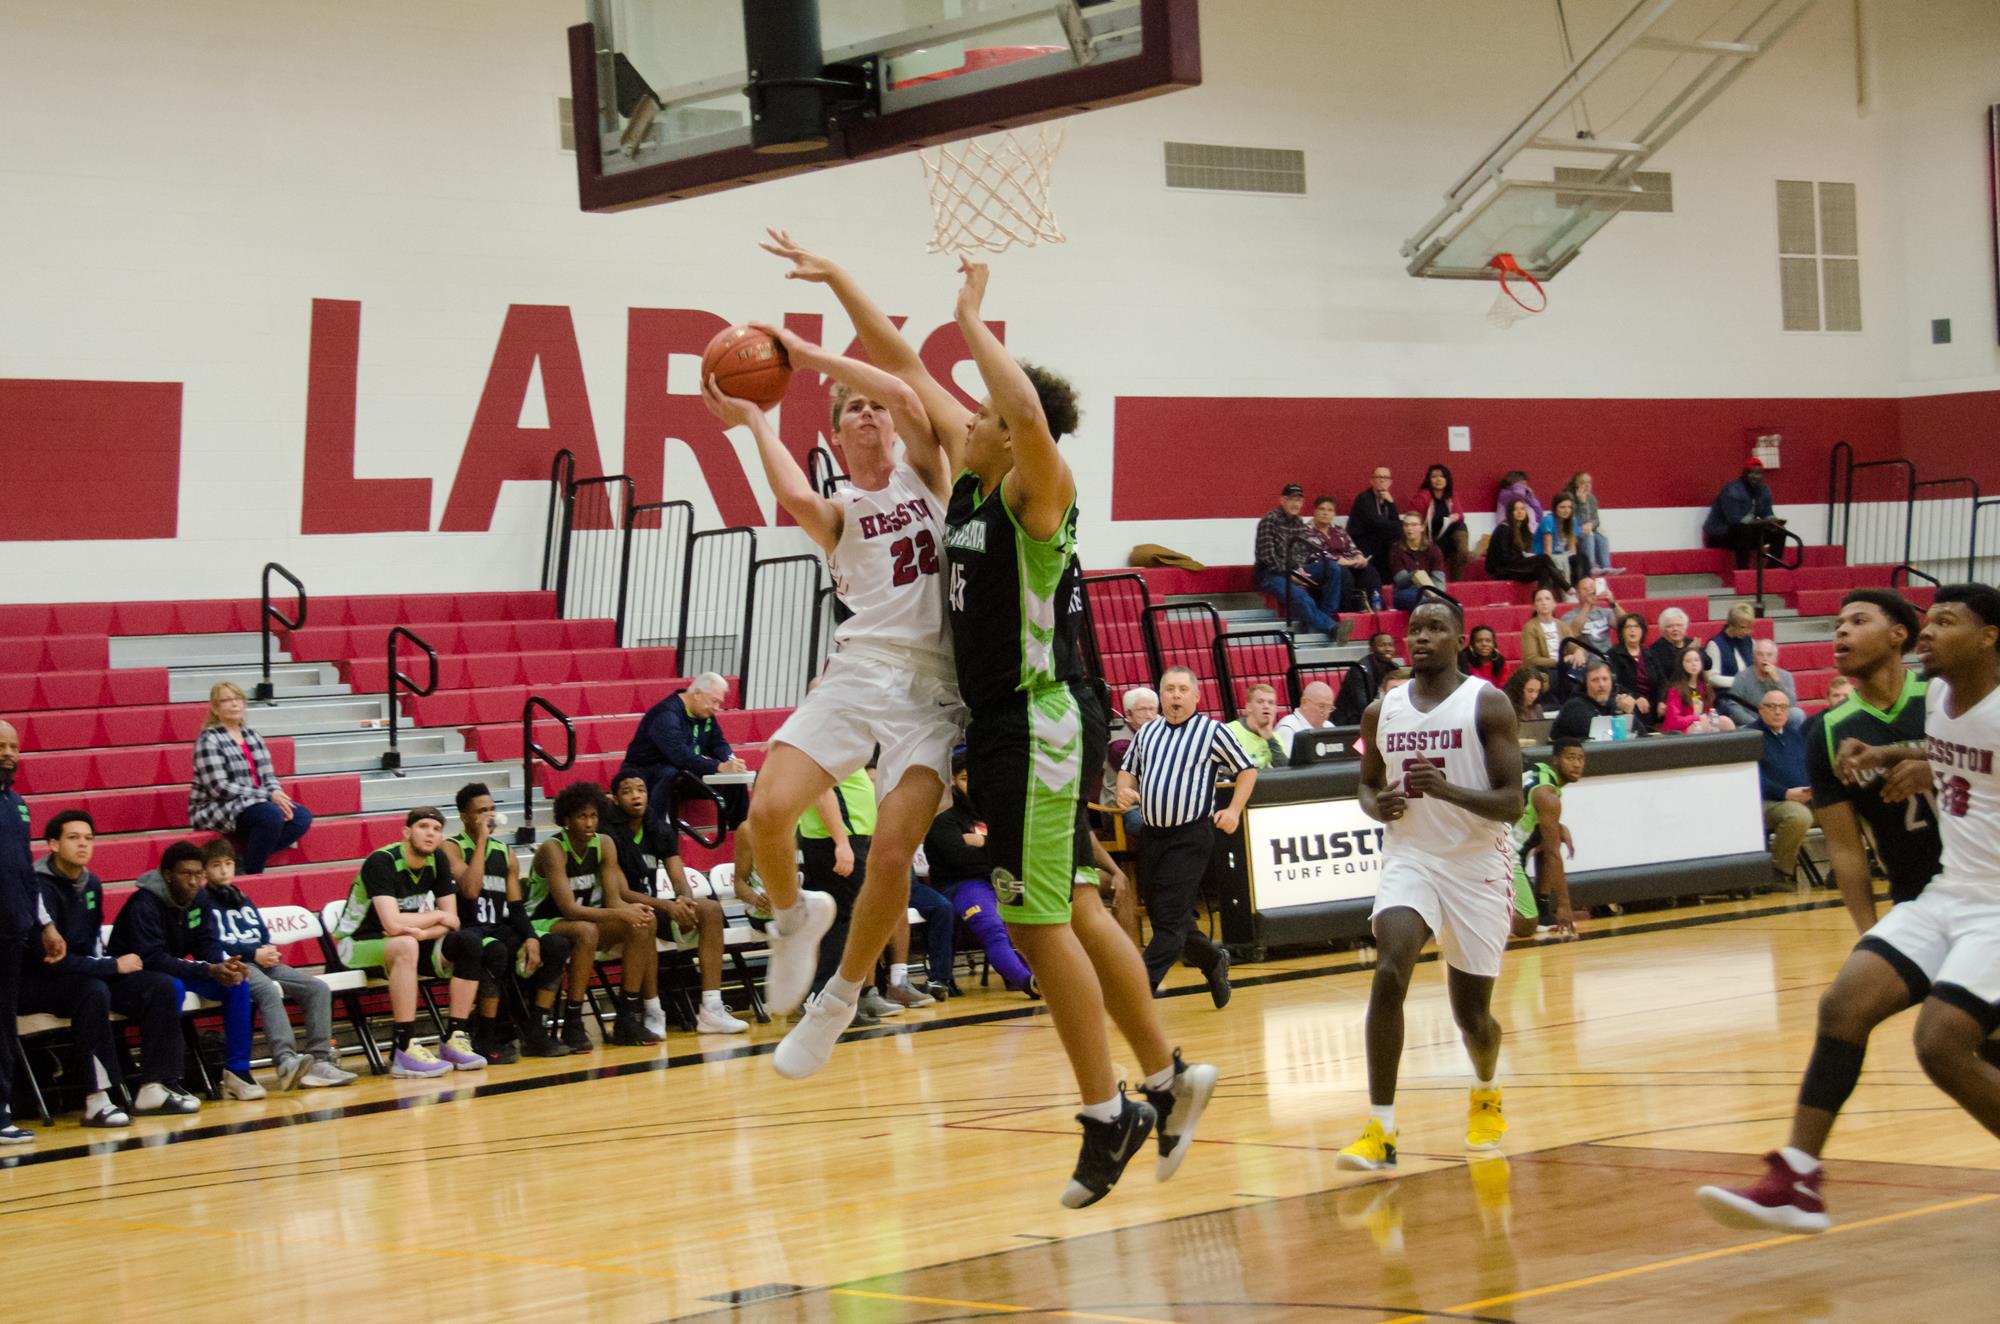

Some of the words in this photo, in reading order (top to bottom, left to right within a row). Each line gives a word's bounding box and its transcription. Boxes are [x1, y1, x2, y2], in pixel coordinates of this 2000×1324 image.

[889, 528, 940, 588] 22
[1386, 727, 1463, 753] HESSTON
[1926, 735, 1993, 775] ESSTON
[1274, 866, 1322, 882] TURF
[1333, 859, 1383, 875] EQUI
[266, 914, 309, 934] ARKS
[476, 896, 496, 924] 31
[211, 905, 263, 945] LCS
